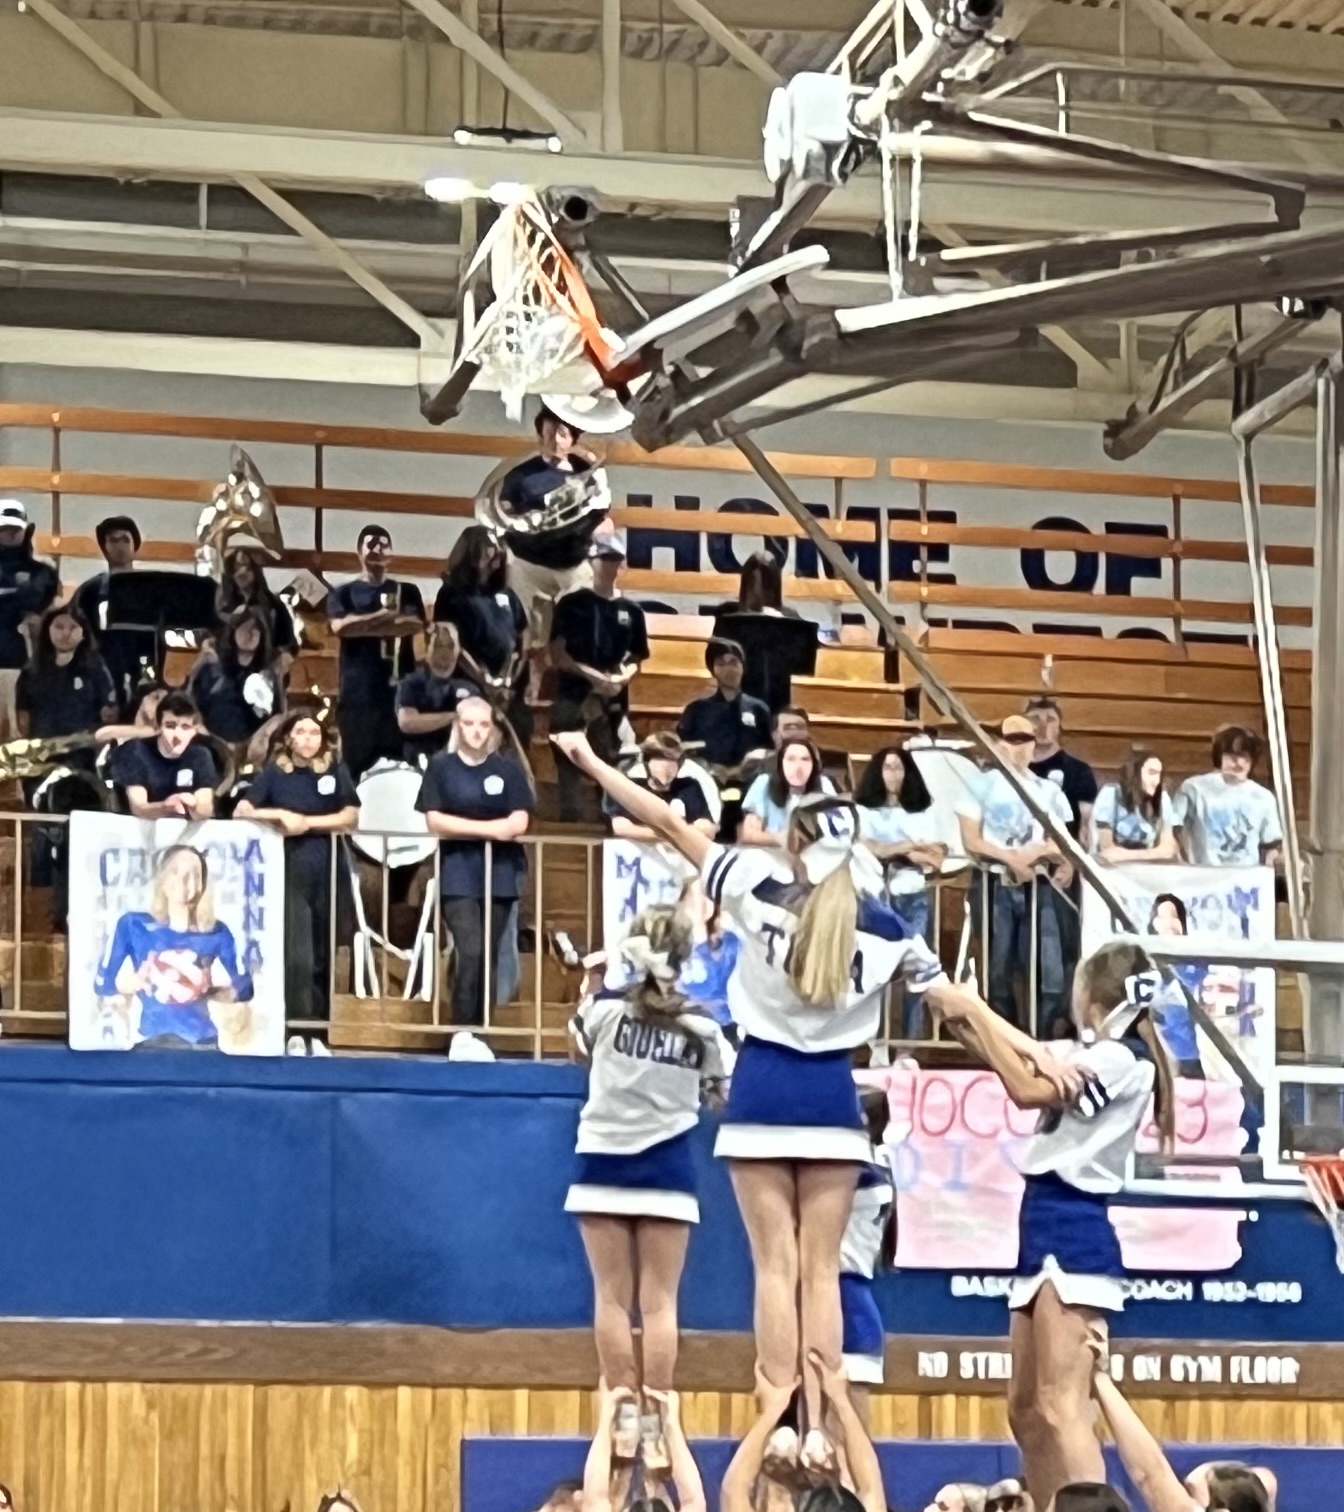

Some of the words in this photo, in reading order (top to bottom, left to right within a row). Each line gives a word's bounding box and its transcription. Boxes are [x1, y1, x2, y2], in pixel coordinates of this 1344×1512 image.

[626, 494, 957, 592] HOME
[1019, 516, 1169, 596] OF
[1170, 1355, 1222, 1383] GYM
[1230, 1356, 1300, 1385] FLOOR
